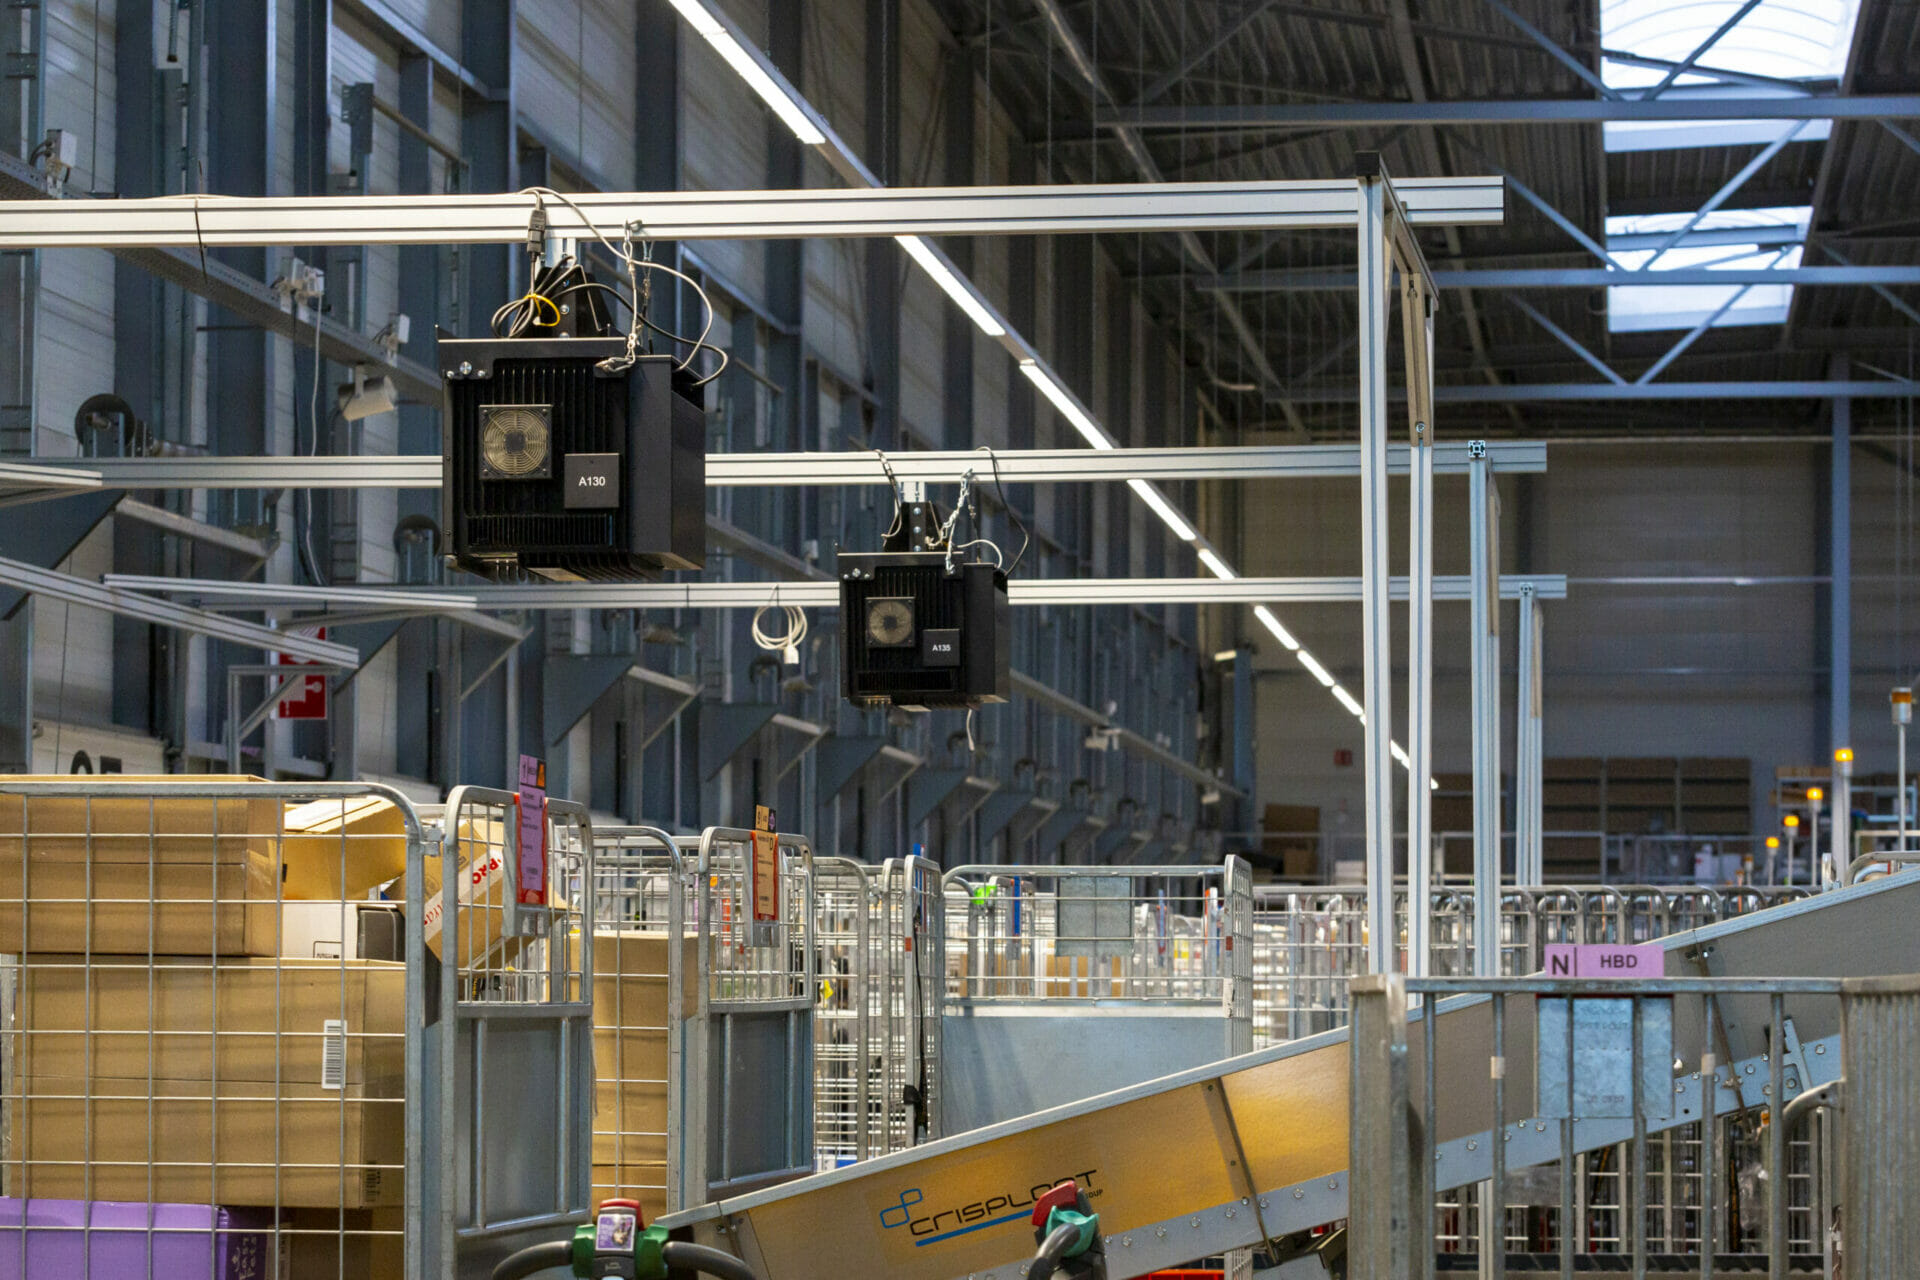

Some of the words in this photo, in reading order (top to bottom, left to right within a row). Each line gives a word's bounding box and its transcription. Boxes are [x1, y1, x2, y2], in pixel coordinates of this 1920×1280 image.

[578, 476, 606, 487] A130
[932, 644, 951, 652] A135
[1552, 954, 1569, 975] N
[1600, 955, 1638, 969] HBD
